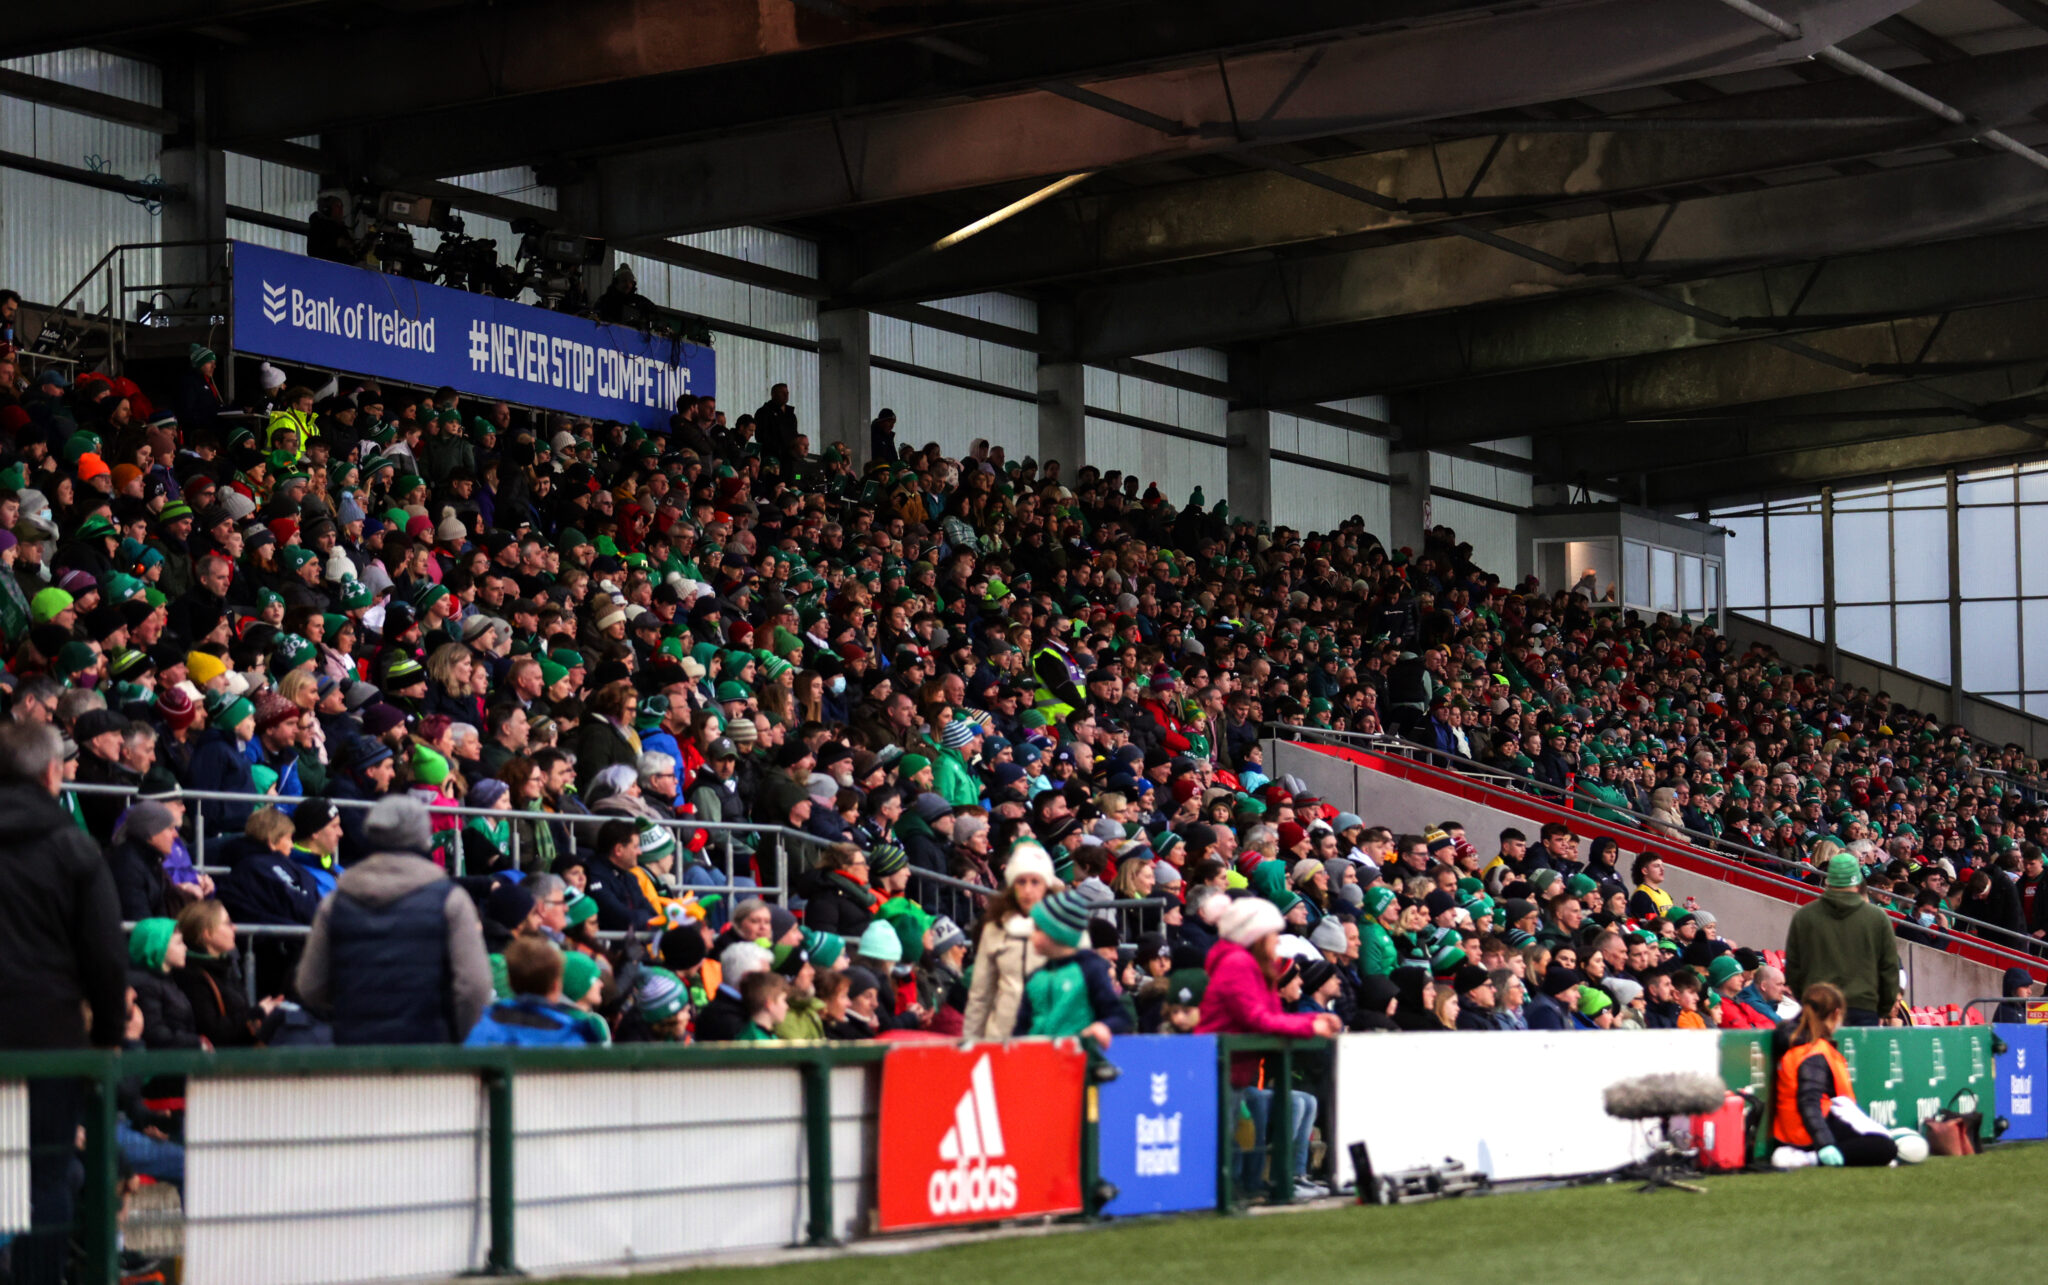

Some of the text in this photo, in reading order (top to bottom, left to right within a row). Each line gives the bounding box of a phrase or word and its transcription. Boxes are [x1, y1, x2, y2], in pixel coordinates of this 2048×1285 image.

[292, 288, 436, 353] Bank of Ireland
[469, 319, 691, 413] #NEVER STOP COMPETING
[1136, 1113, 1165, 1143] Bank
[929, 1158, 1018, 1215] adidas
[1136, 1143, 1180, 1176] Ireland
